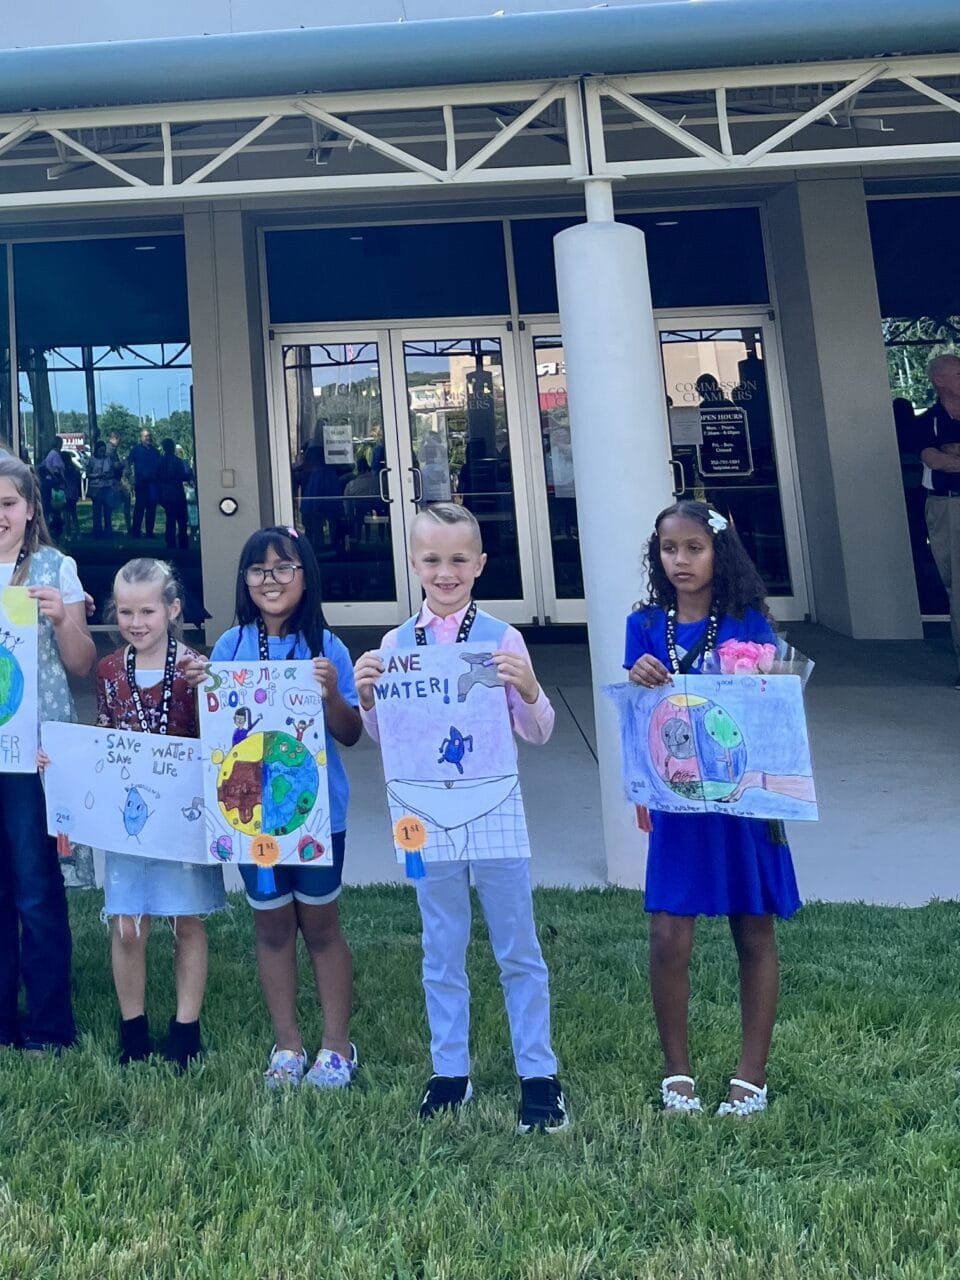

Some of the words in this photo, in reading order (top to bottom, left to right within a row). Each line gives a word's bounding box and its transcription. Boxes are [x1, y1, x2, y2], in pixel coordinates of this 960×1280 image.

[675, 380, 758, 393] COMMISSION
[683, 390, 753, 402] CHAMBERS
[387, 654, 422, 673] AVE
[373, 677, 450, 704] WATER!
[401, 824, 420, 841] 1st
